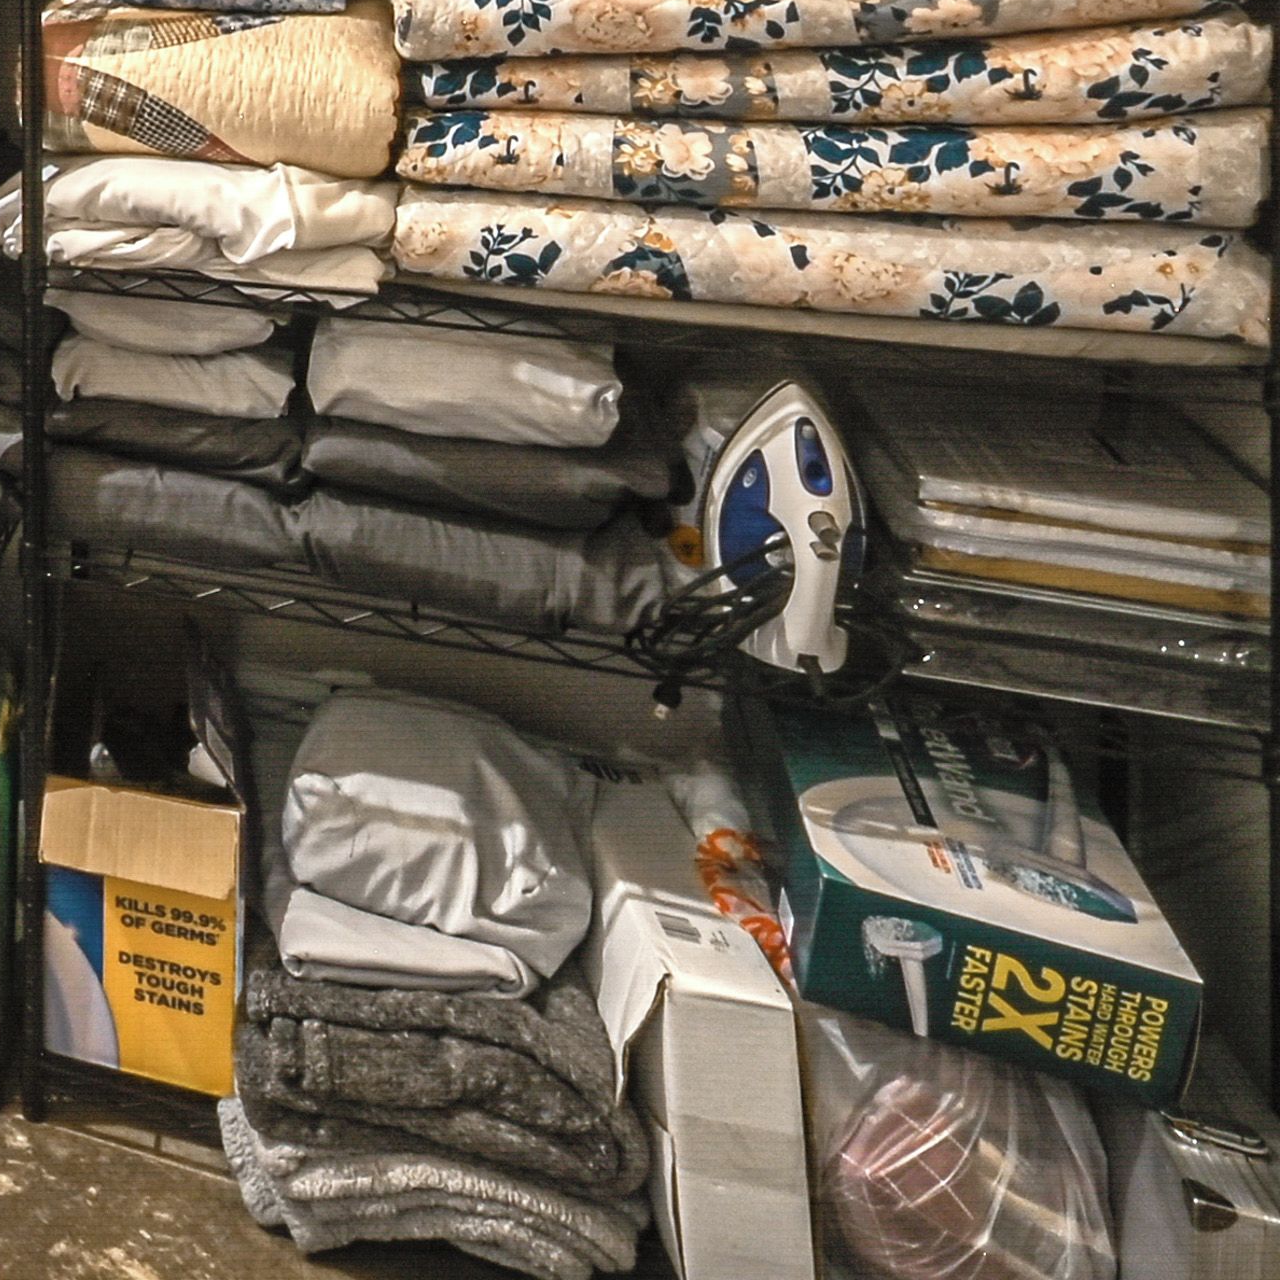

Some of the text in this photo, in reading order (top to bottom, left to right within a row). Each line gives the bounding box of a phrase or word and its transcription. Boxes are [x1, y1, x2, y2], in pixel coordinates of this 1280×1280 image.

[115, 894, 227, 932] KILLS 99.9%
[120, 914, 146, 929] OF
[118, 951, 222, 986] DESTROYS
[134, 971, 204, 999] TOUGH
[134, 988, 204, 1016] STAINS
[950, 944, 992, 1033] FASTER
[981, 952, 1067, 1051] 2X
[1055, 975, 1098, 1062] STAINS
[1086, 983, 1118, 1066] HARD WATER
[1104, 991, 1142, 1074] THROUGH
[1128, 995, 1169, 1082] POWERS
